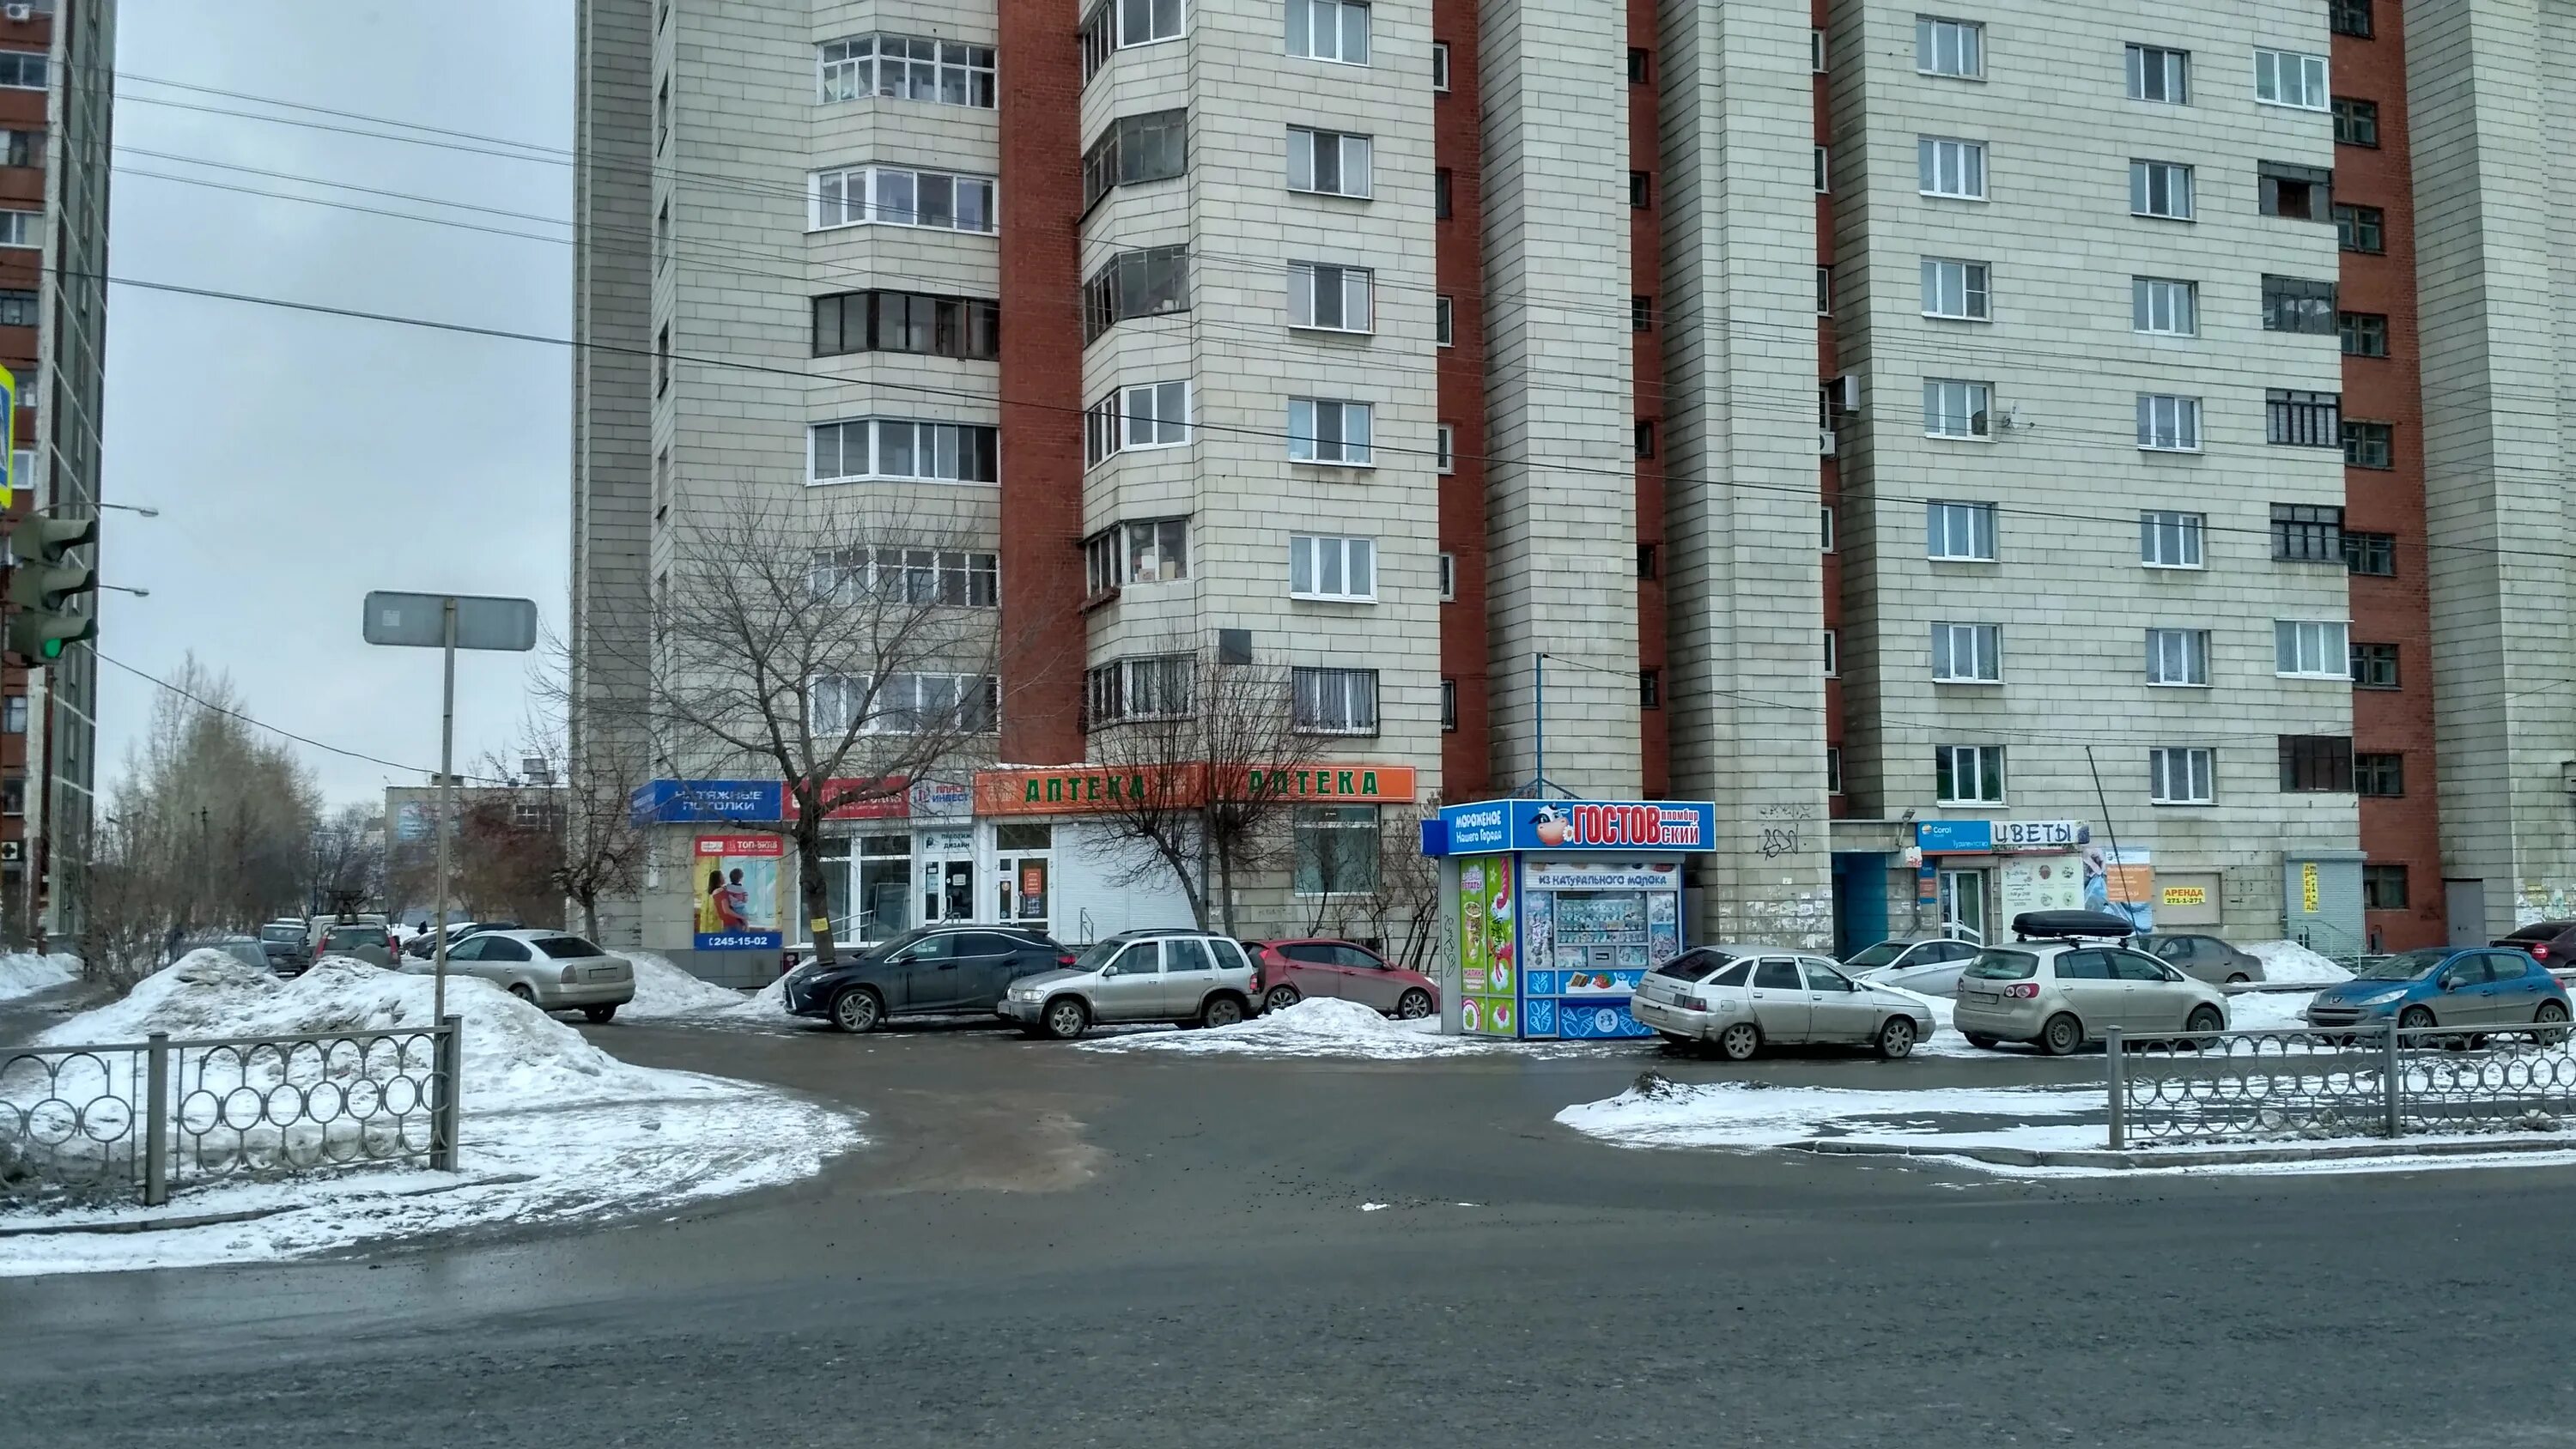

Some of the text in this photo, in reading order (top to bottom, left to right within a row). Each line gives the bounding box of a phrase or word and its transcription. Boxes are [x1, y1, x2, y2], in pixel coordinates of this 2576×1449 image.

[1025, 775, 1145, 803] АПТЕКА
[1248, 769, 1379, 795] АПТЕКА
[932, 794, 969, 803] ИНВЕСТ
[1455, 810, 1501, 828] МОРОЖЕНОЕ
[1573, 804, 1662, 845] ГОСТОВ
[1662, 809, 1699, 822] пломбир
[1456, 828, 1502, 844] Нашего Города
[1994, 824, 2072, 845] ЦВЕТЫ
[714, 937, 768, 946] 245-15-02
